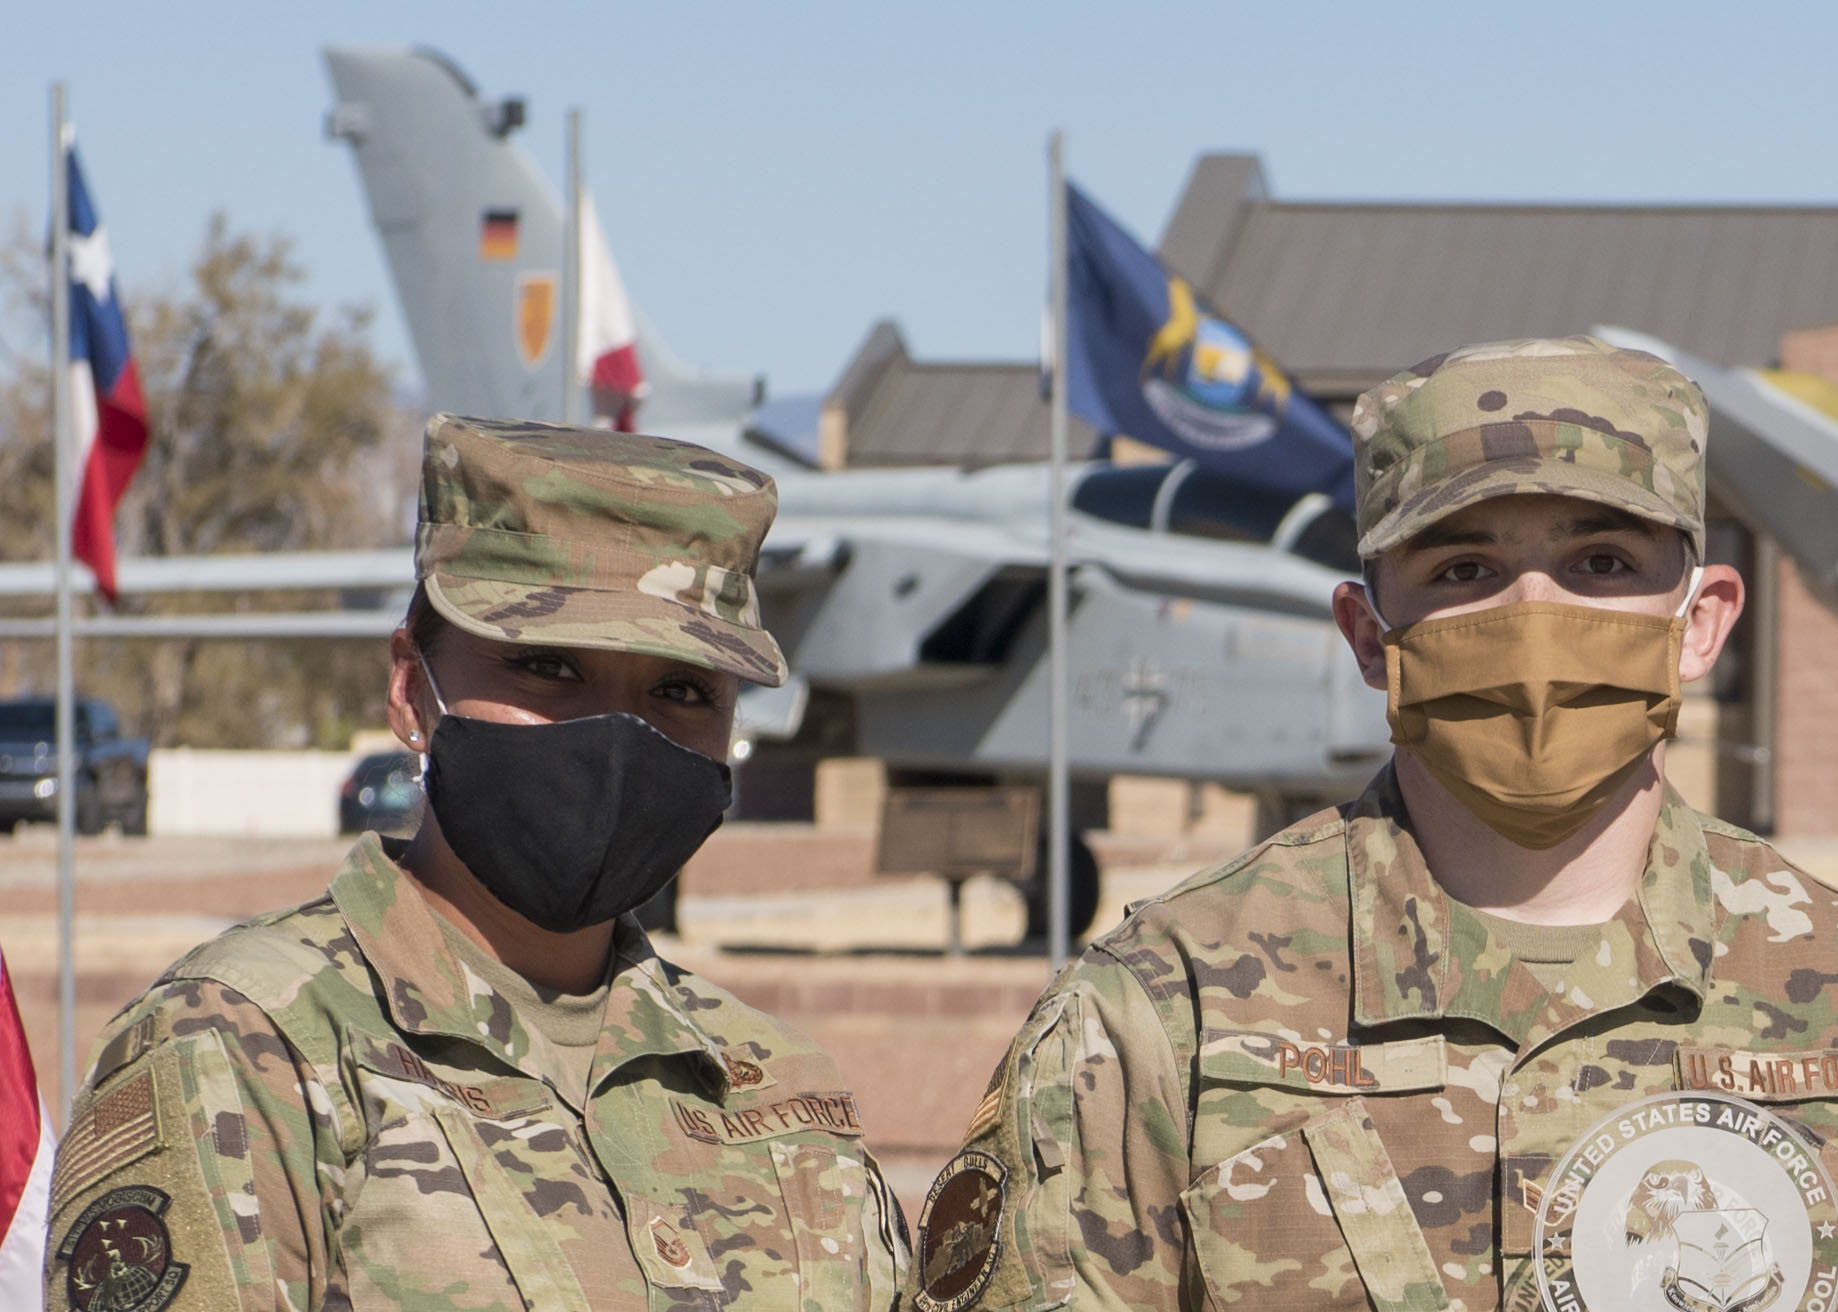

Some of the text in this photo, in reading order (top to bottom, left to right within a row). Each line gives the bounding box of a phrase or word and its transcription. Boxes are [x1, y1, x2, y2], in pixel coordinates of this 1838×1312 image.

[1279, 1041, 1374, 1086] POHL
[1688, 1054, 1744, 1092] U.S.
[1750, 1060, 1796, 1093] AIR
[720, 1110, 774, 1138] AIR
[770, 1096, 861, 1130] FORCE
[963, 1155, 987, 1170] BULLS
[1554, 1102, 1827, 1214] UNITED STATES AIR FORCE
